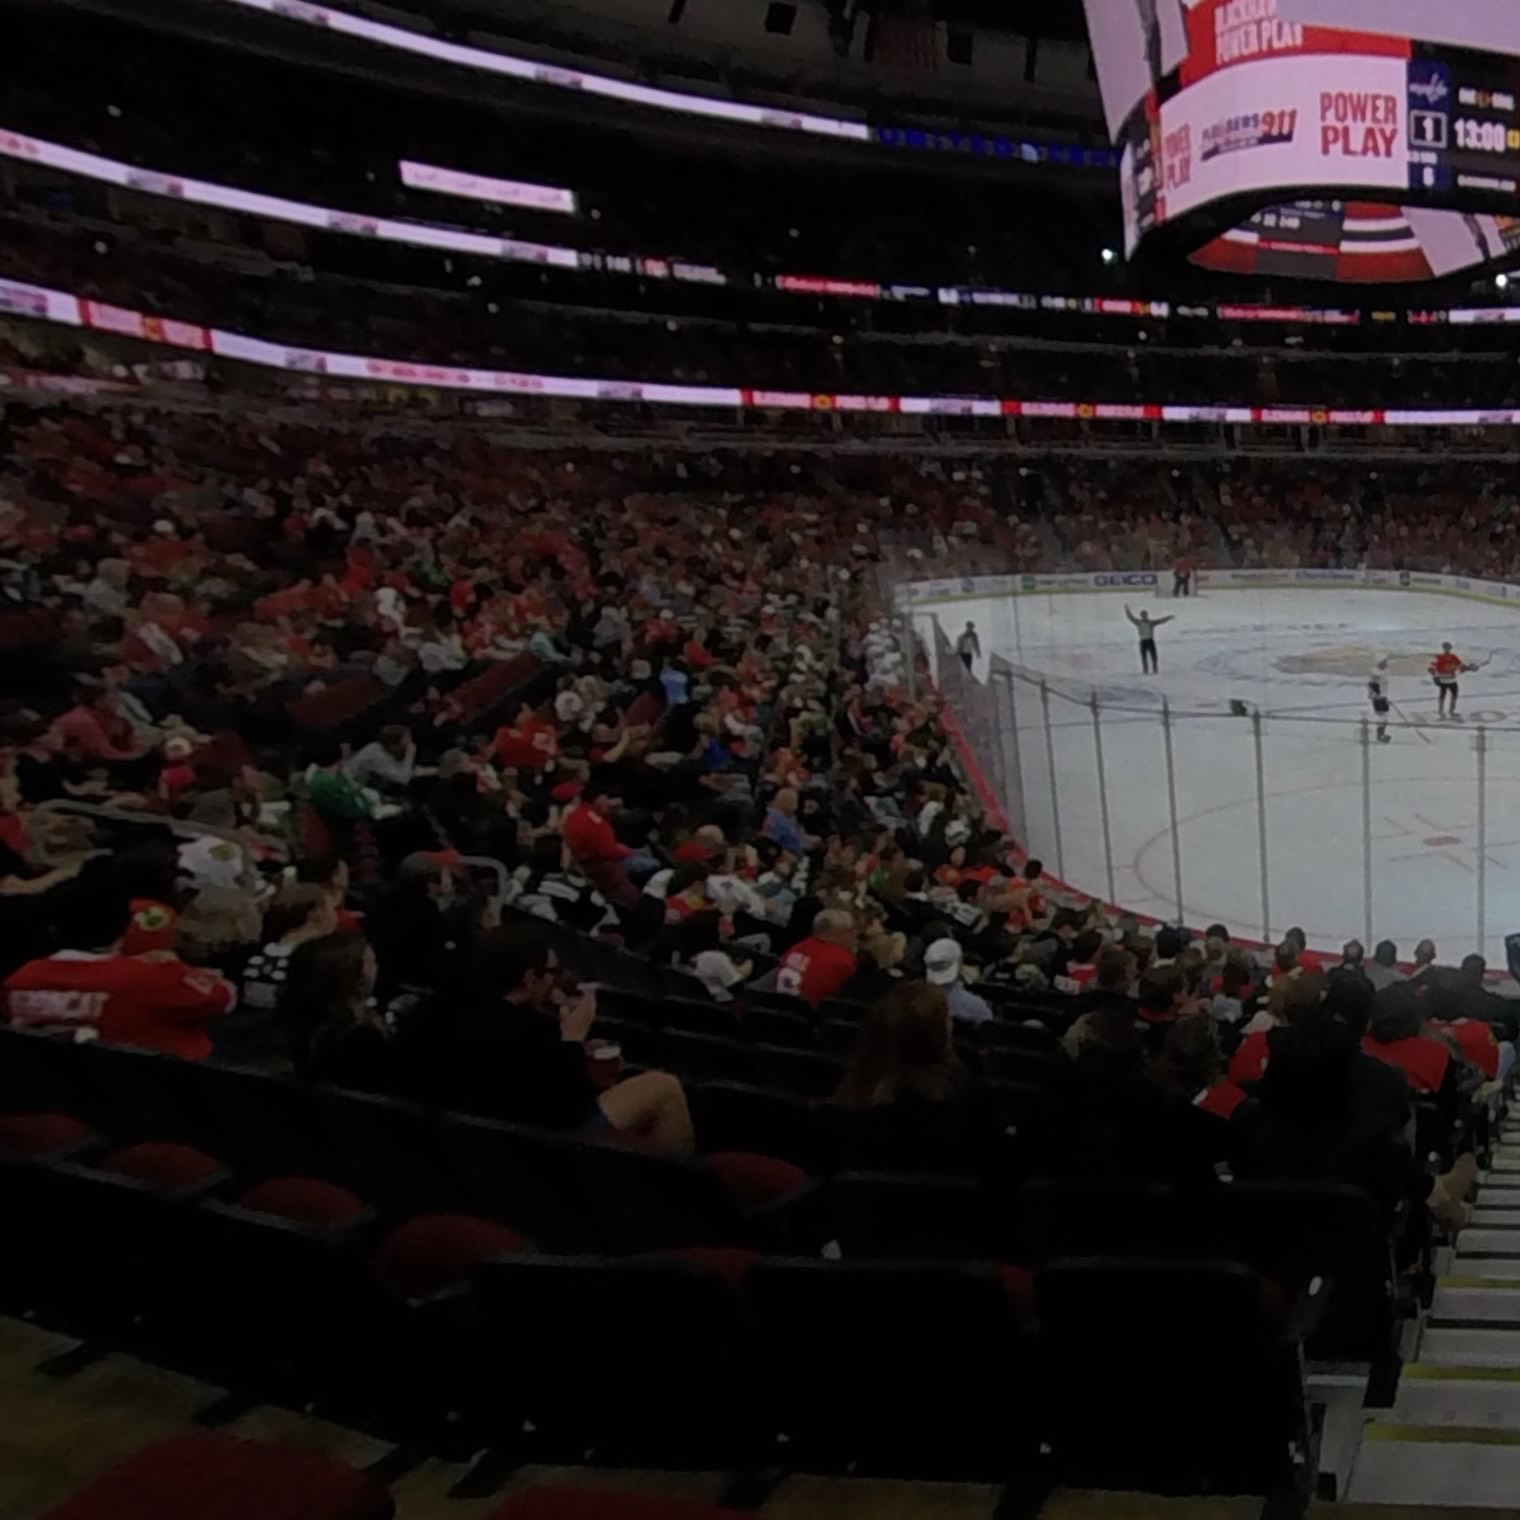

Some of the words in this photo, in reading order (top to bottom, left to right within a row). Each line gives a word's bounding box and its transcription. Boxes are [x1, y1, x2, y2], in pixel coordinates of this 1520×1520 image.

[1320, 92, 1398, 125] POWER
[1321, 125, 1398, 157] PLAY
[1093, 574, 1157, 587] GEICO
